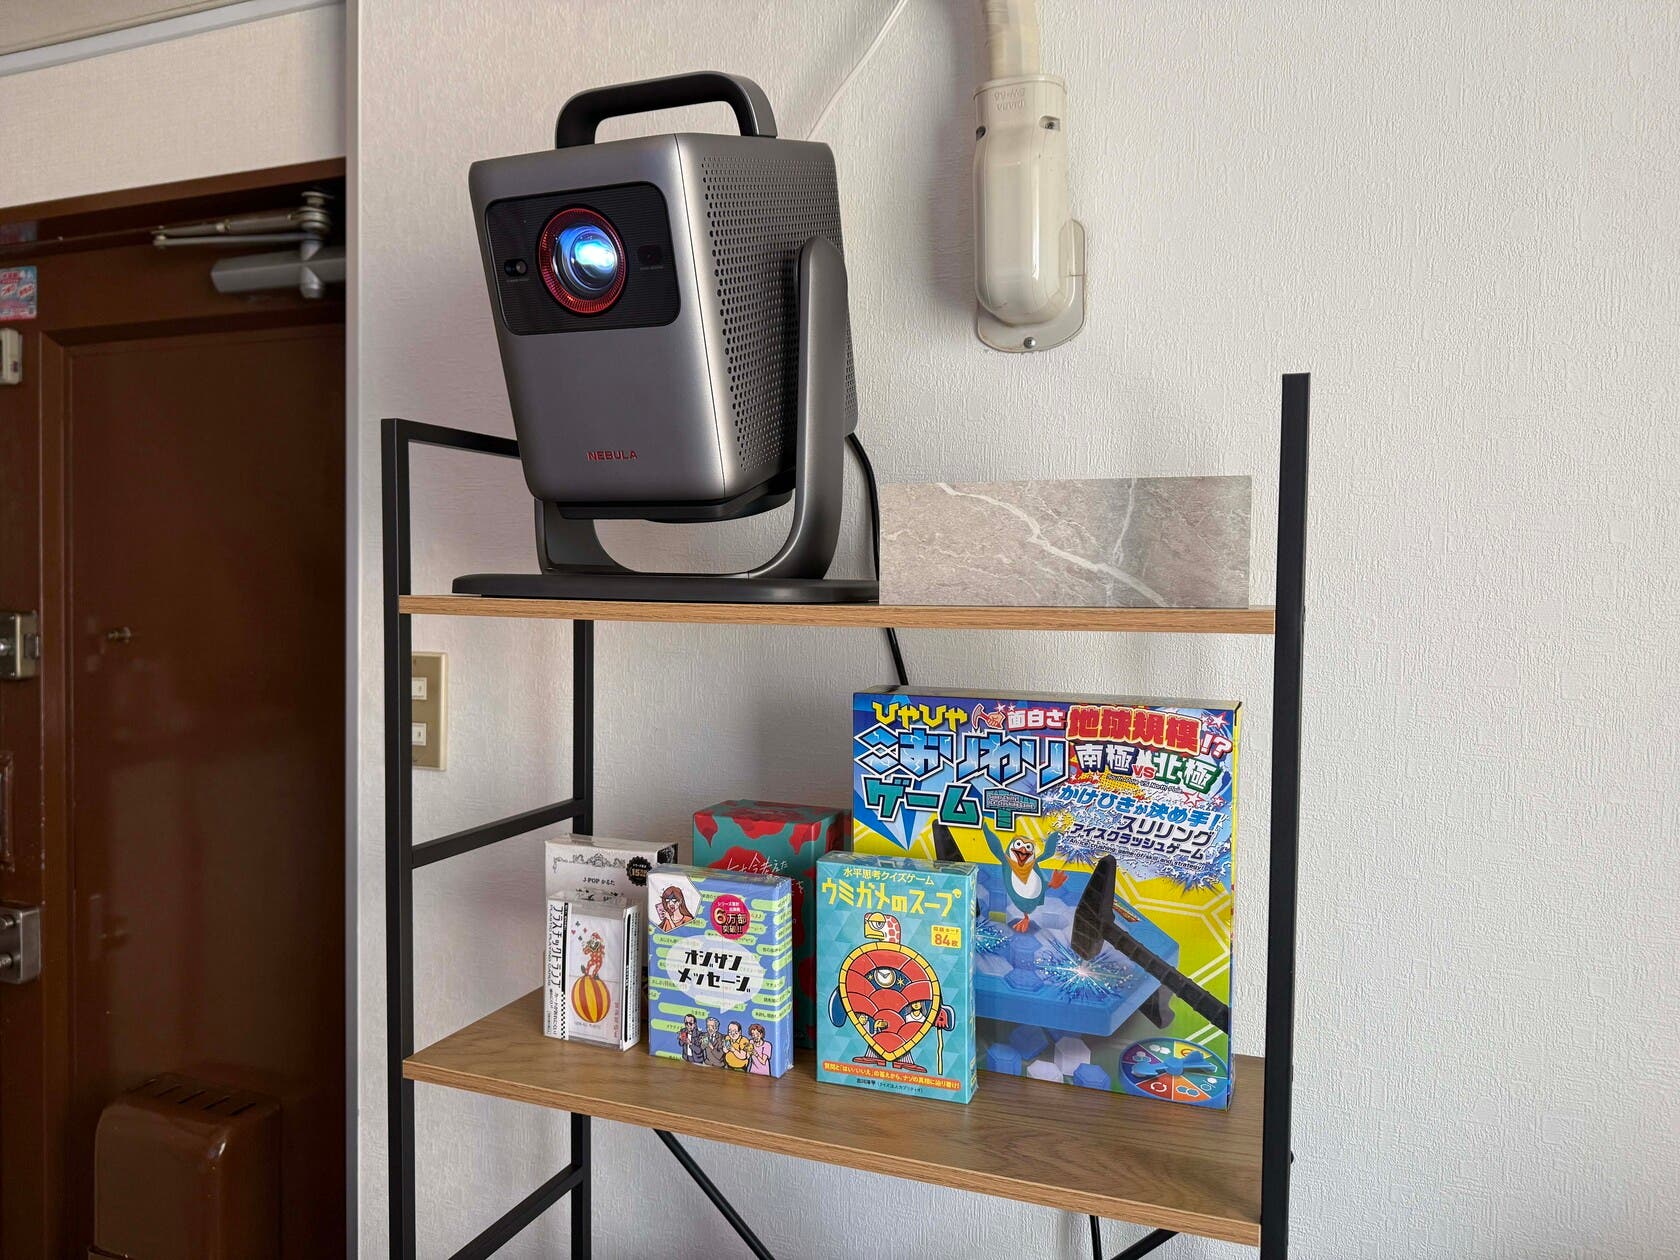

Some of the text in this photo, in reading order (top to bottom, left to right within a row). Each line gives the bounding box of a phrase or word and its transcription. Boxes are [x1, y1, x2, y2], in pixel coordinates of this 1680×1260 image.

[587, 449, 638, 462] NEBULA
[872, 701, 968, 731] ひやひや
[1007, 707, 1065, 735] 面白さ
[861, 774, 985, 830] ゲーム
[1058, 785, 1221, 831] かけひきが決め手!
[1070, 823, 1204, 861] アイスクラッシュゲーム
[1117, 815, 1215, 847] スリリング
[1090, 842, 1116, 854] crushing
[842, 866, 935, 886] 水平思考クイズゲーム
[821, 877, 962, 918] ウミガメのスープ
[714, 906, 747, 926] 6万部
[684, 948, 743, 972] オジサン
[677, 967, 752, 993] メッセージ
